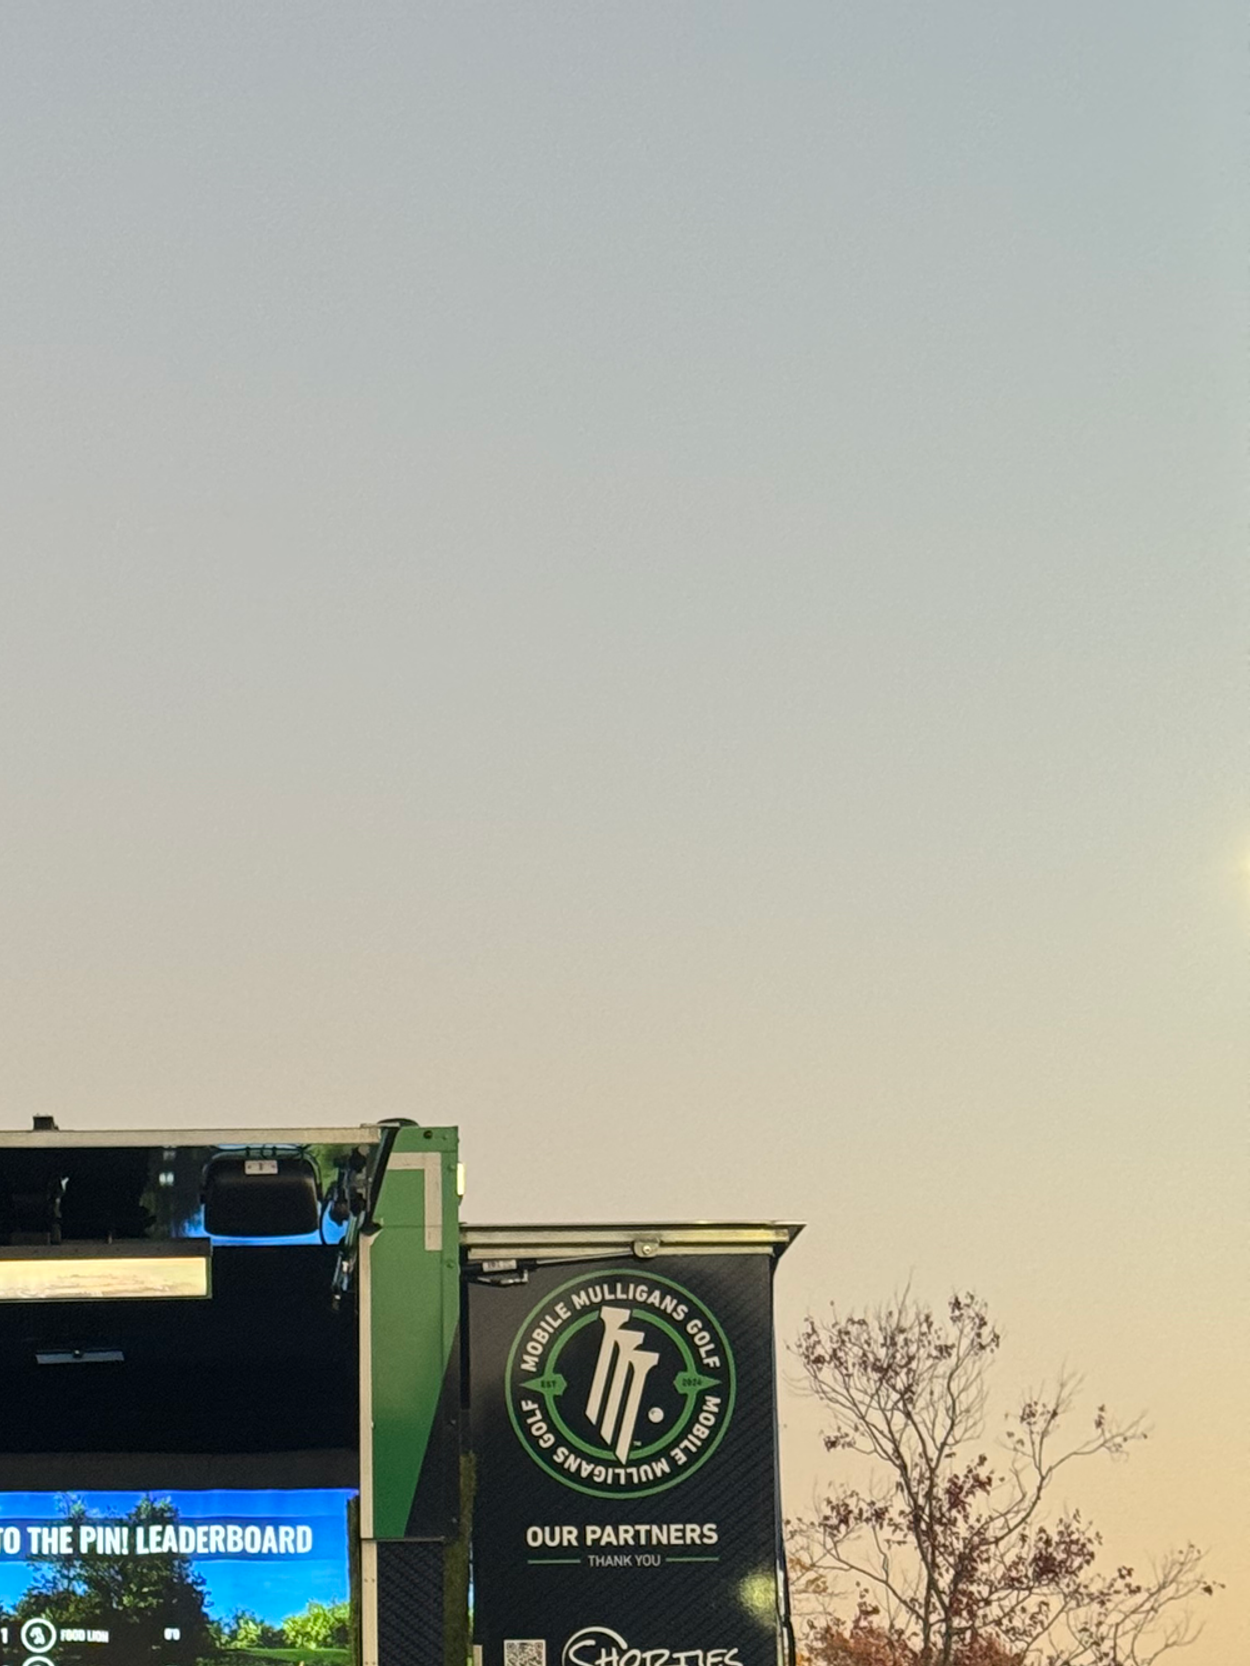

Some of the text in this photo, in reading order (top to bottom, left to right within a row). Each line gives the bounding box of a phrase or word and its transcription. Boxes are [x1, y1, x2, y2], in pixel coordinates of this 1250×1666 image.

[520, 1282, 720, 1372] MOBILE MULLIGANS GOLF
[522, 1396, 721, 1484] MOBILE MULLIGANS GOLF
[27, 1526, 73, 1554] THE
[79, 1526, 129, 1554] PIN!
[135, 1525, 313, 1555] LEADERBOARD
[526, 1523, 718, 1548] OUR PARTNERS
[588, 1554, 660, 1568] THANK YOU
[1, 1628, 109, 1643] 1 FOOD LION
